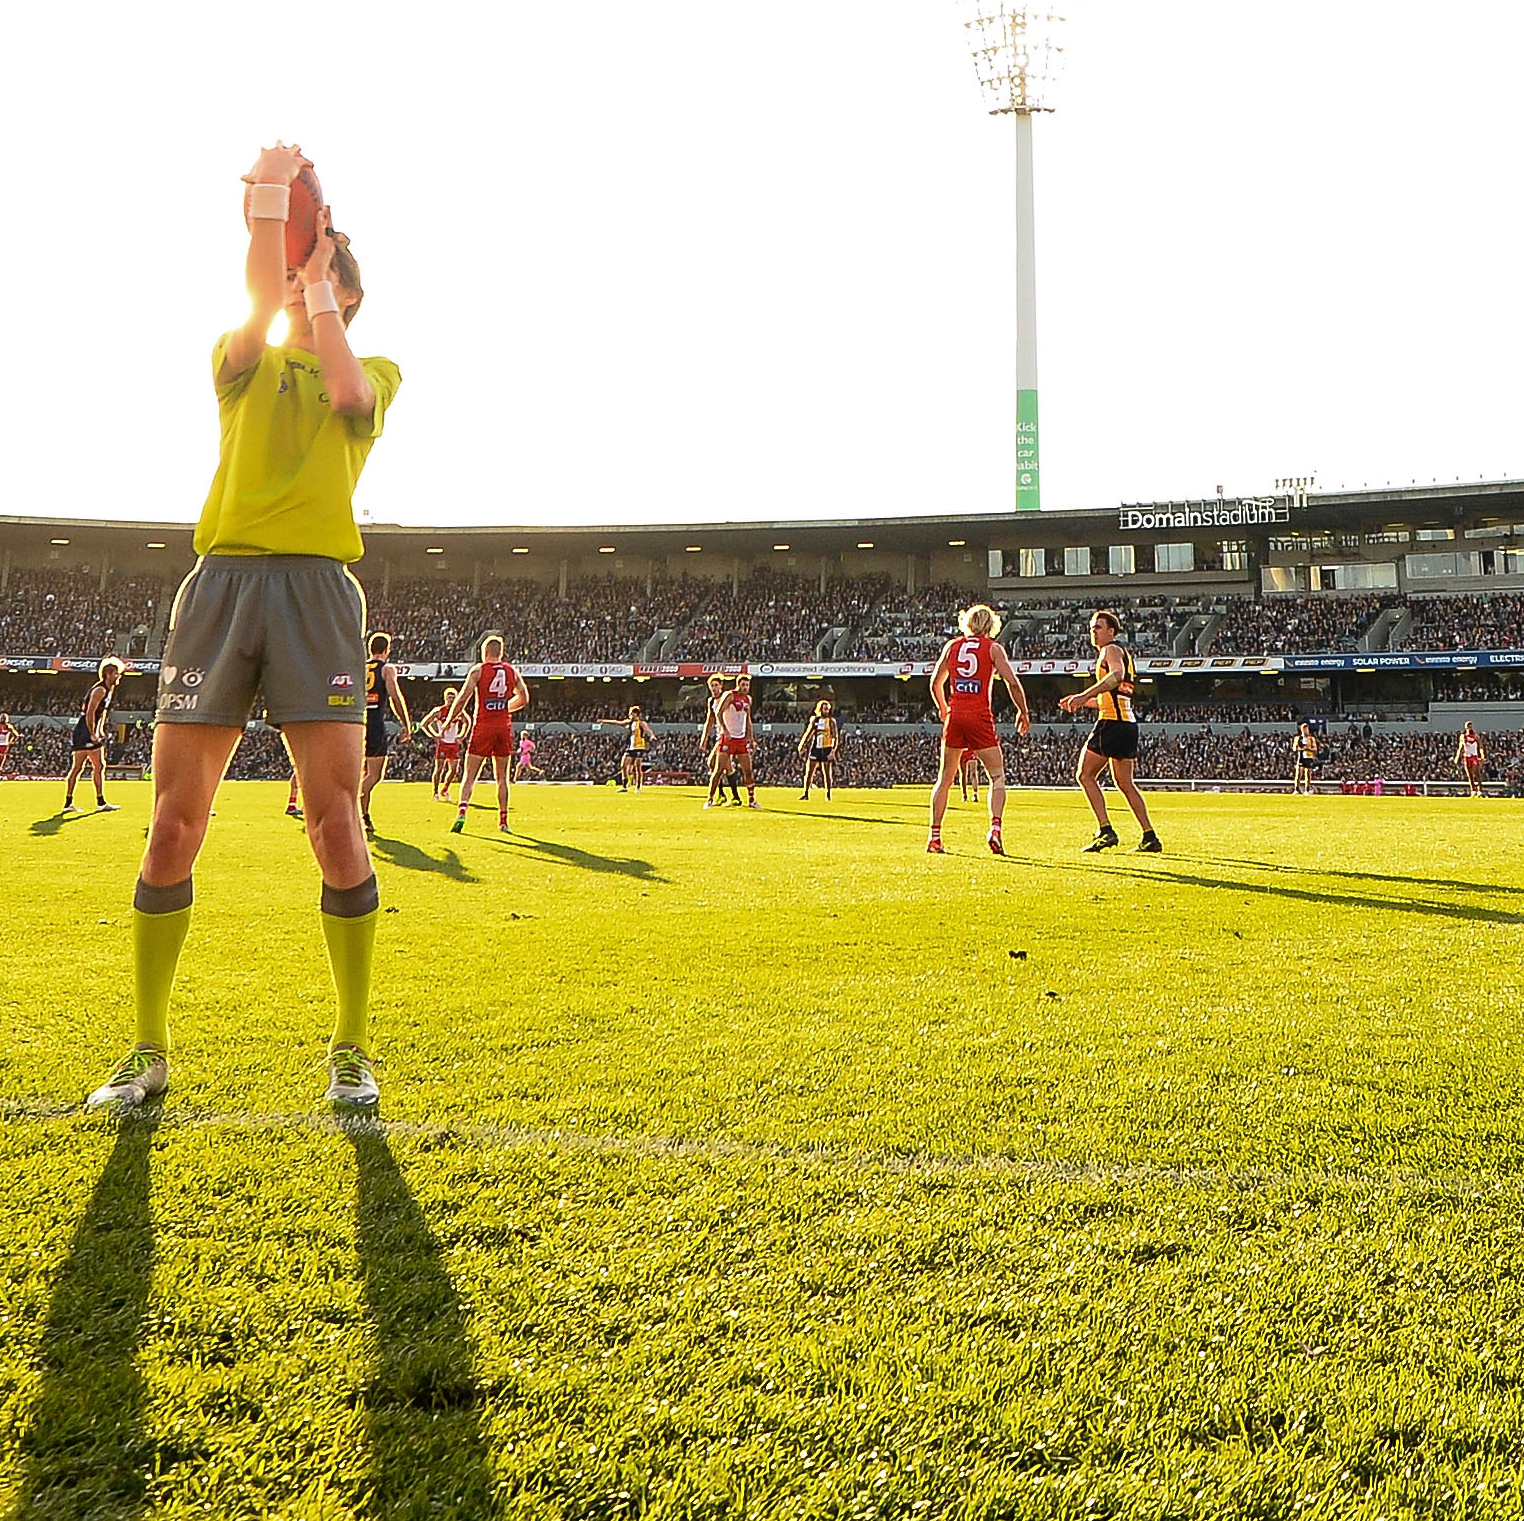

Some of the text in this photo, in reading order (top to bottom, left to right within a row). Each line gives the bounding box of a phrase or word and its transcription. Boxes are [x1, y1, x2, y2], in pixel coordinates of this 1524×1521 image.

[1017, 435, 1035, 445] the
[1016, 460, 1039, 471] abit
[956, 641, 980, 678] 5
[1352, 657, 1410, 666] SOLAR POWER
[331, 673, 354, 685] AFL
[488, 668, 508, 698] 4
[956, 681, 980, 694] citi
[160, 693, 198, 710] OPSM
[486, 700, 506, 710] citi
